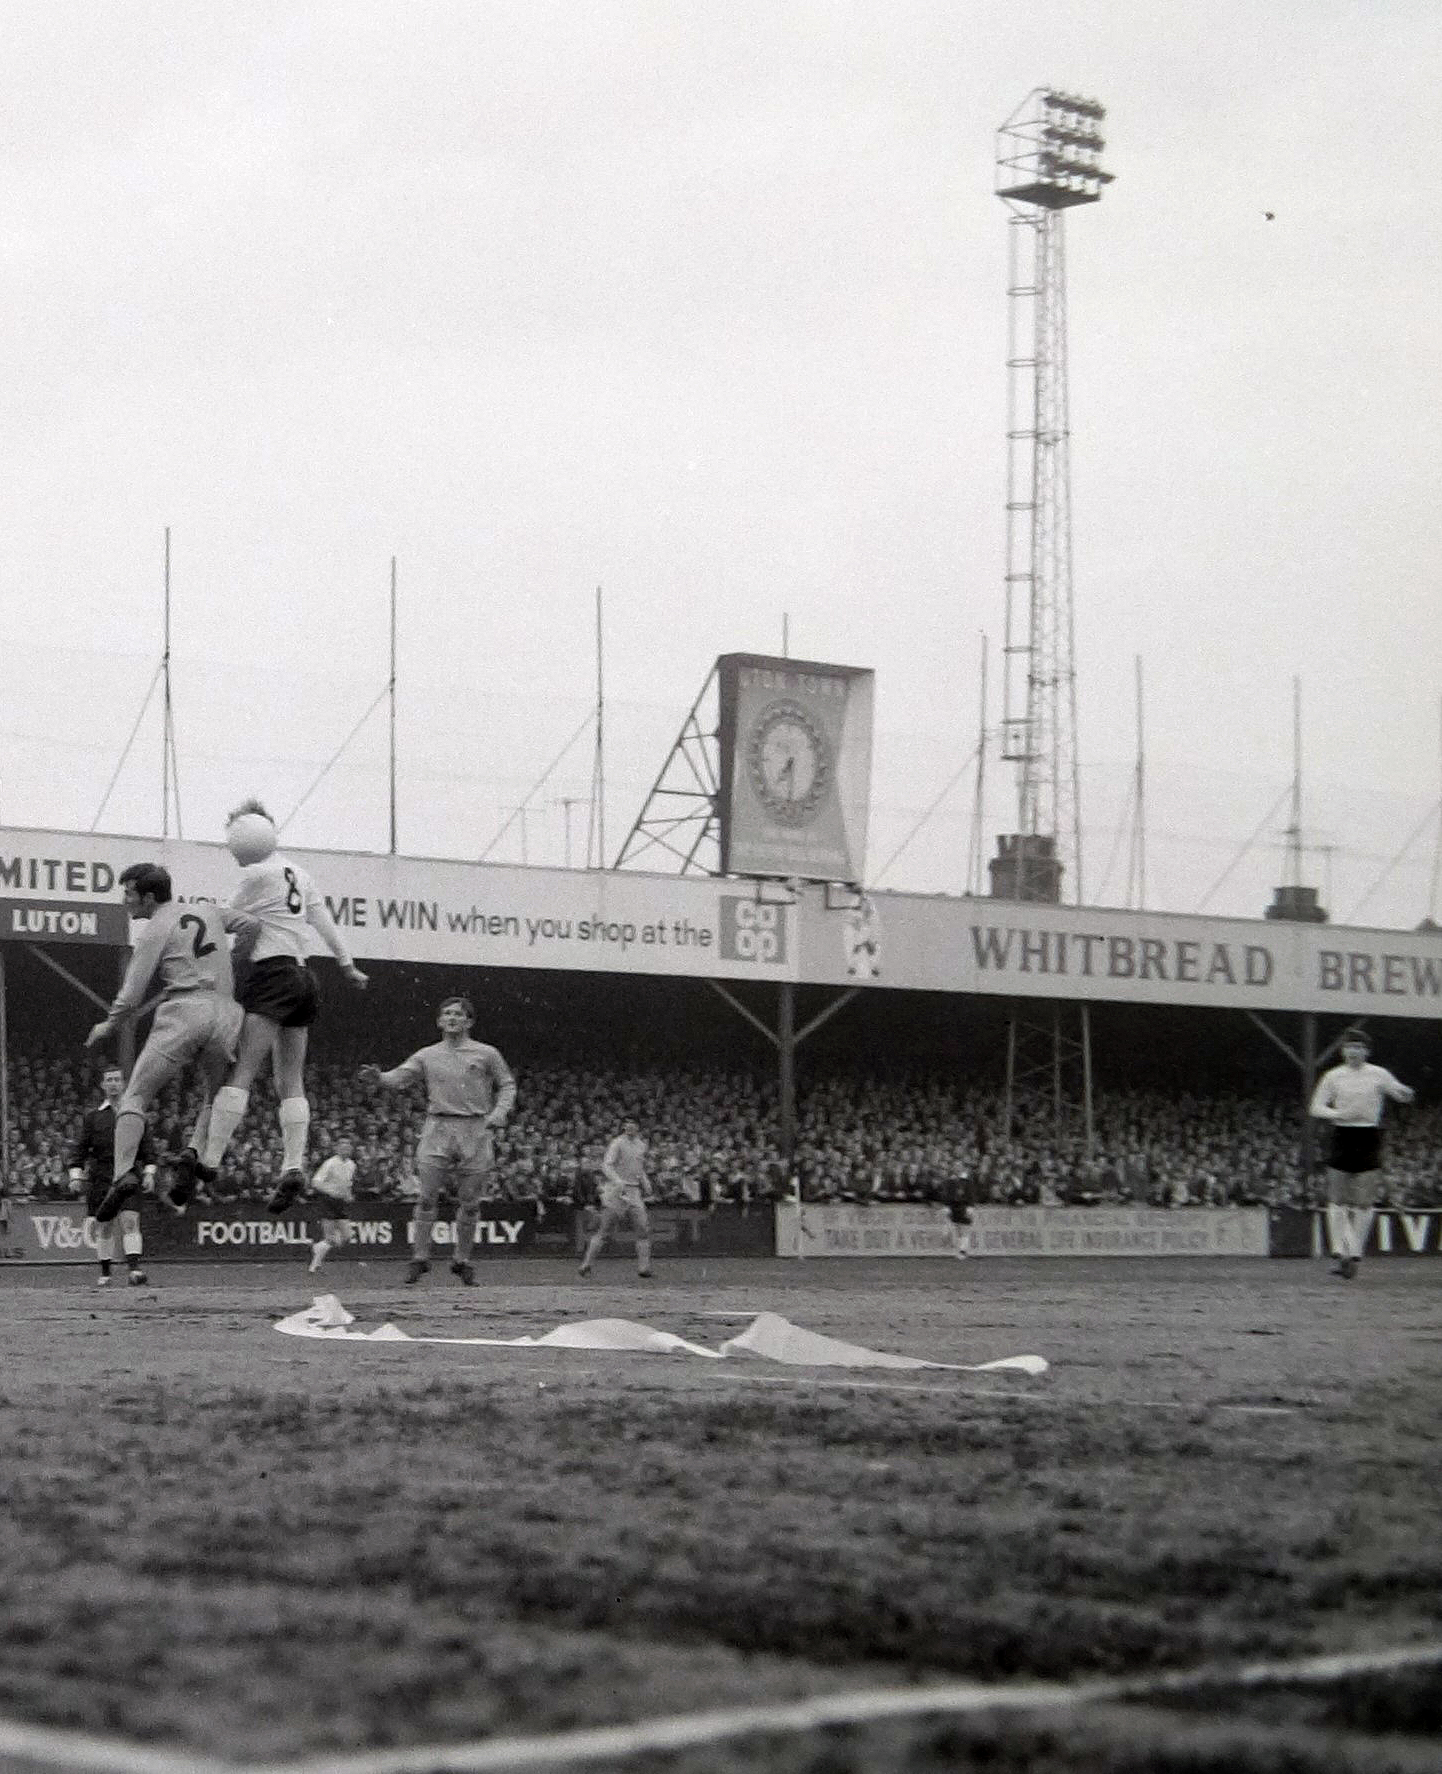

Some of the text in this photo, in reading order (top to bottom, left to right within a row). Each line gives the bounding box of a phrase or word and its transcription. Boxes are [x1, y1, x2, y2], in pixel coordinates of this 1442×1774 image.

[284, 866, 302, 914] 8
[11, 908, 99, 936] LUTON
[179, 913, 218, 959] 2
[323, 896, 713, 951] ME WIN when you shop at the
[968, 924, 1275, 987] WHITBREAD
[196, 1220, 525, 1246] FOOTBALL EWS GTLY
